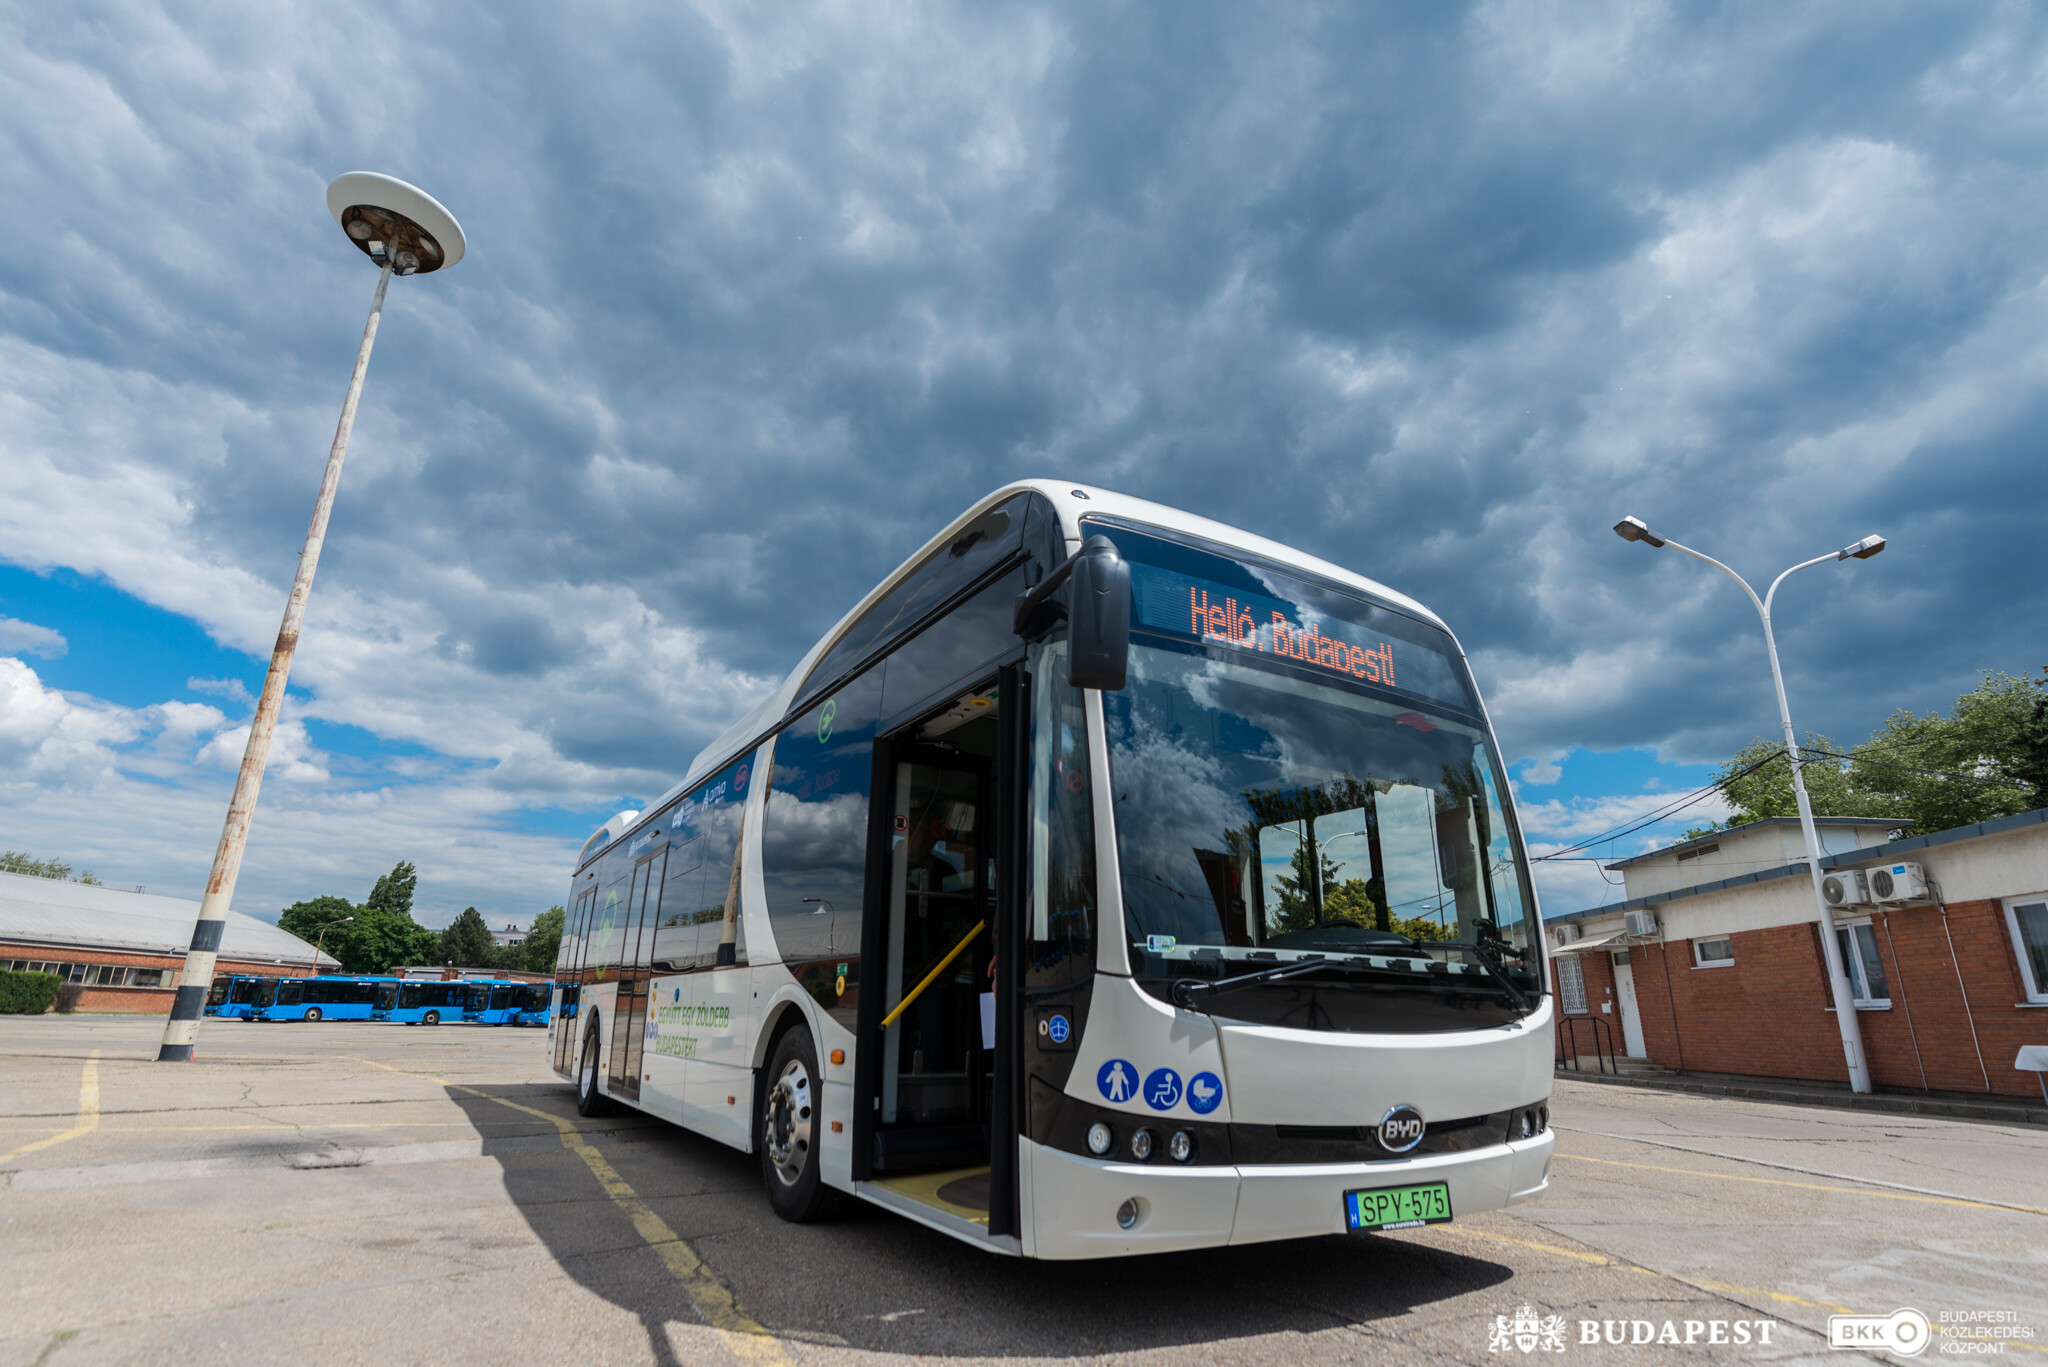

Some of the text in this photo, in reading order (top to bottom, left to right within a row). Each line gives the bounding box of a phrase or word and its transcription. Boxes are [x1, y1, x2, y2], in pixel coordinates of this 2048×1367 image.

[1272, 611, 1395, 687] Budapest!
[682, 1006, 696, 1026] EGY
[696, 1002, 730, 1028] ZÖLDEBB
[655, 1031, 698, 1057] BUDAPESTÉRT
[1385, 1119, 1421, 1139] BYD
[1363, 1189, 1445, 1222] SPY-575
